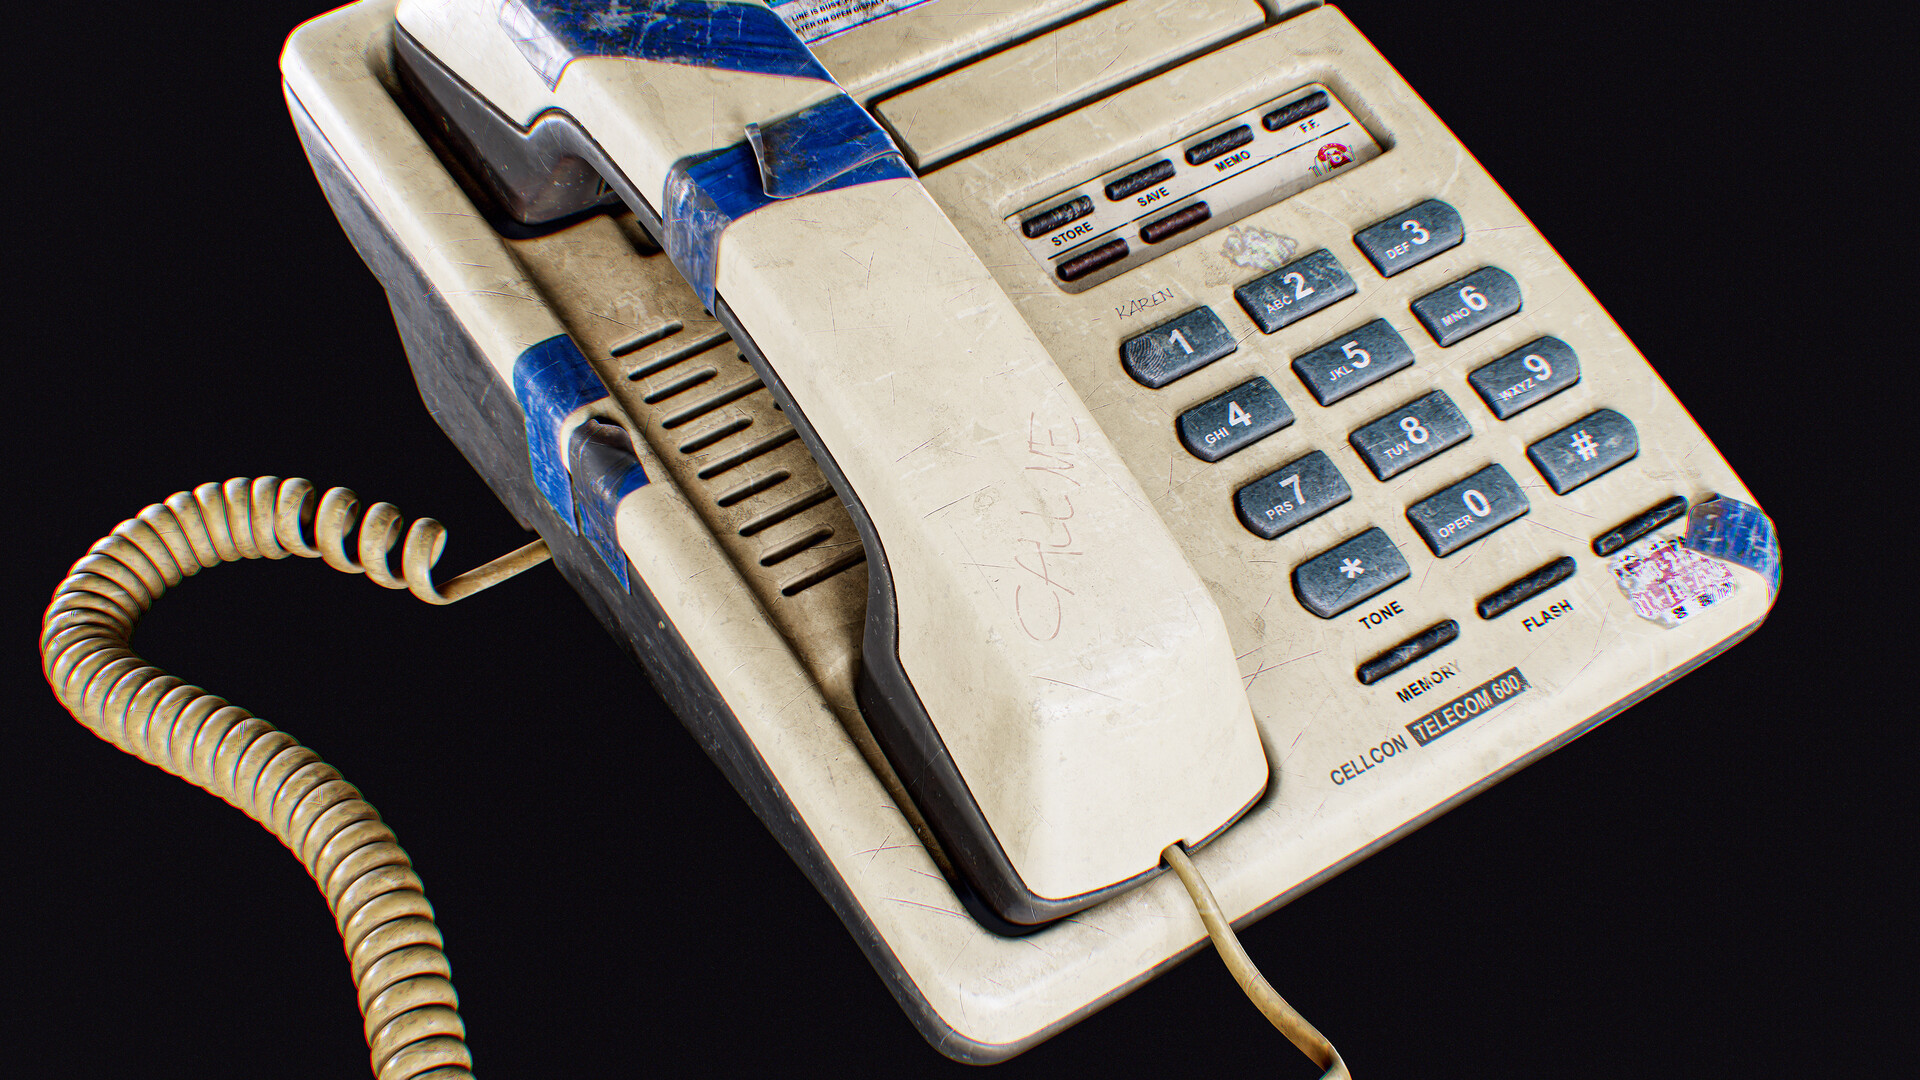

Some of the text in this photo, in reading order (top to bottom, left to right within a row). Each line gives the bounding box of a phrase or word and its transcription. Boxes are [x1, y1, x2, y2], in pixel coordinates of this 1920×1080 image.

[810, 7, 819, 16] IS
[817, 15, 830, 26] ON
[830, 7, 853, 21] OPEN
[1214, 150, 1252, 173] MEMO
[1137, 186, 1170, 208] SAVE
[1050, 221, 1094, 247] STORE
[1385, 219, 1431, 261] DEF 3
[1115, 287, 1175, 320] KAREN
[1266, 272, 1316, 315] ABC 2
[1441, 285, 1489, 328] MNO 6
[1169, 328, 1195, 355] 1
[1329, 340, 1372, 382] JKL 5
[1498, 354, 1552, 402] WXYZ 9
[1204, 401, 1252, 446] GHI 4
[1383, 416, 1430, 461] TUV 8
[1265, 473, 1307, 521] PRS 7
[1438, 488, 1492, 539] OPER 0
[1358, 600, 1405, 631] TONE
[1521, 598, 1574, 633] FLASH
[1395, 659, 1461, 703] MEMORY
[1330, 674, 1520, 786] CELLCON TELECOM 600
